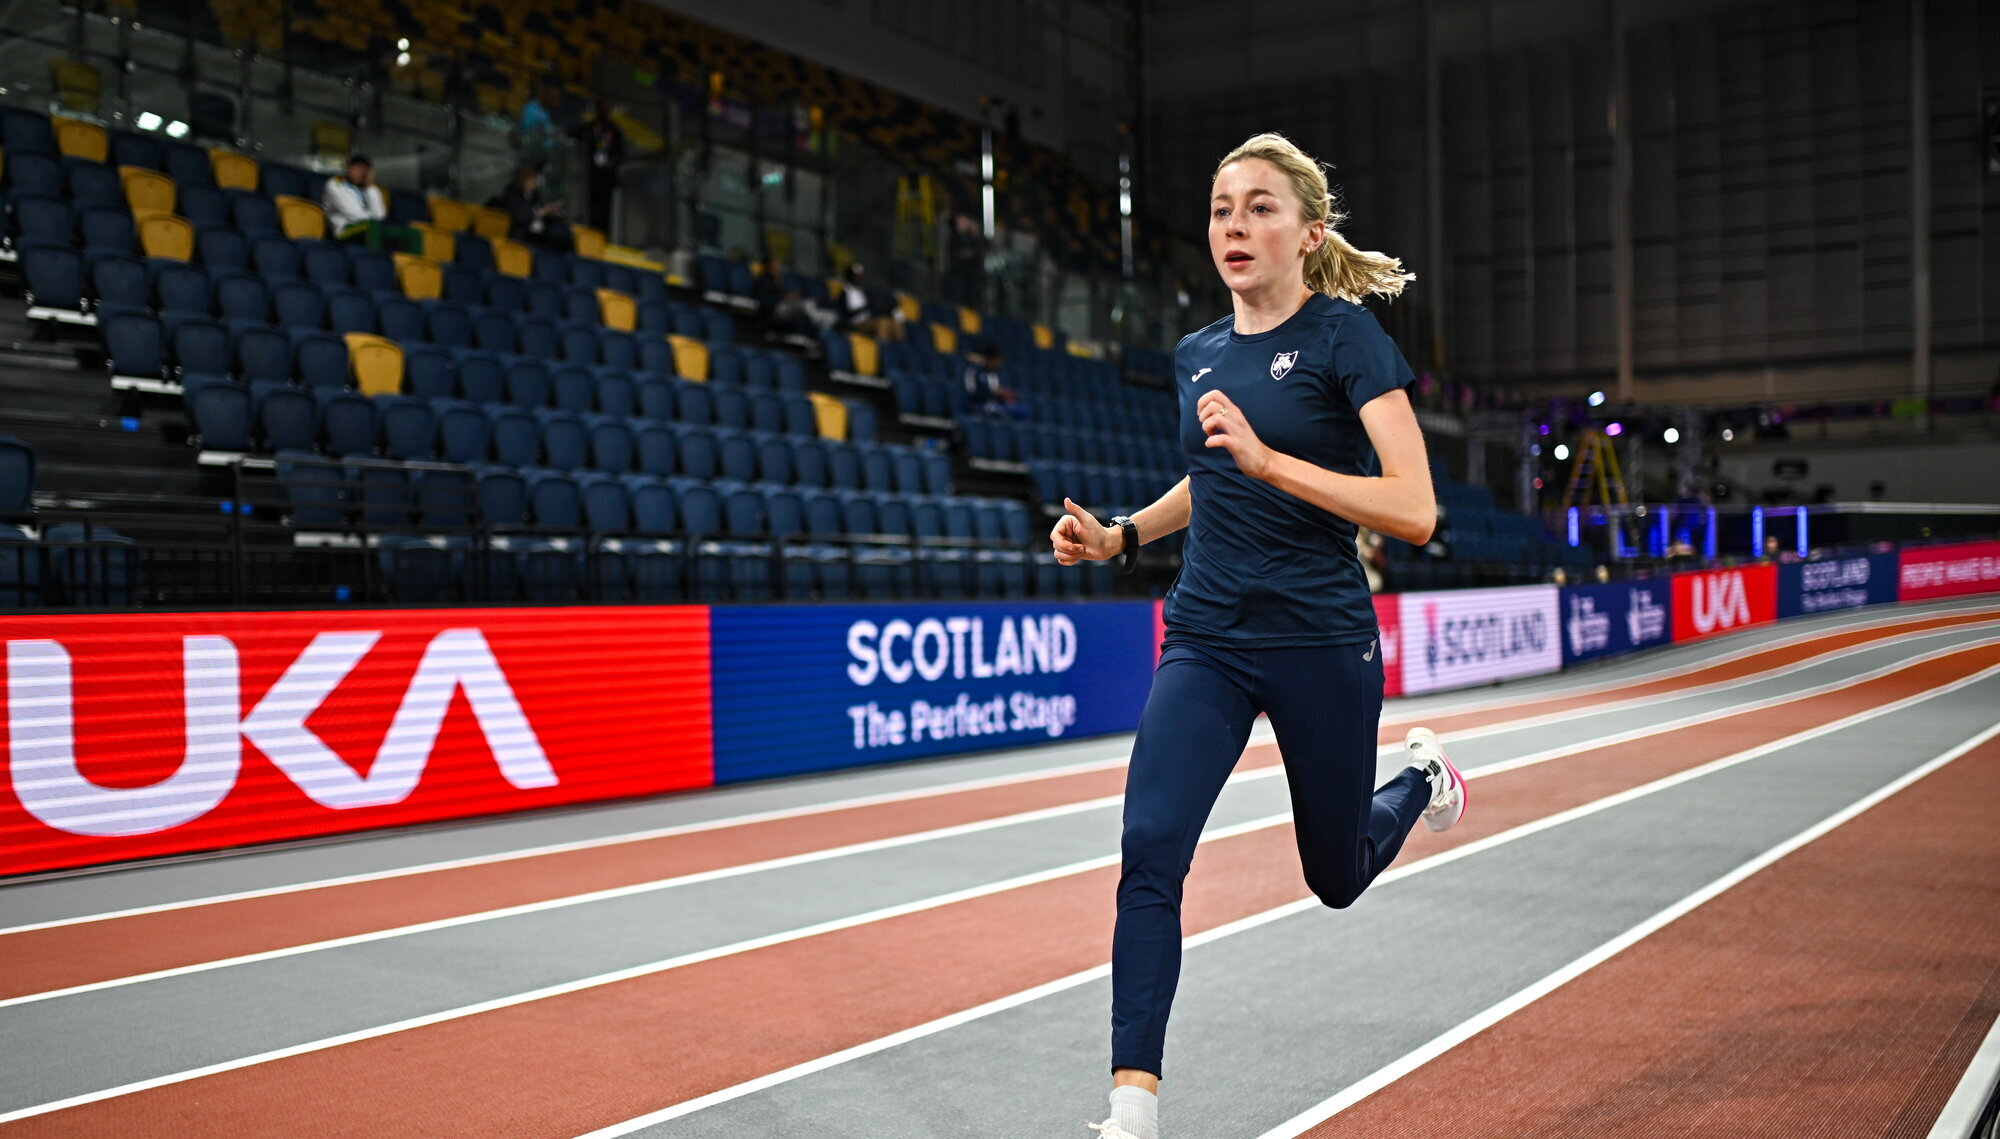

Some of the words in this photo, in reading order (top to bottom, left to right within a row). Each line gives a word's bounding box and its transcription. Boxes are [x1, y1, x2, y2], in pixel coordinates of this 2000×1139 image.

[1691, 571, 1750, 633] UKA
[847, 614, 1077, 686] SCOTLAND
[1443, 610, 1547, 666] SCOTLAND
[6, 628, 559, 837] UKA
[848, 701, 906, 749] The
[911, 692, 1007, 742] Perfect
[1010, 691, 1076, 737] Stage
